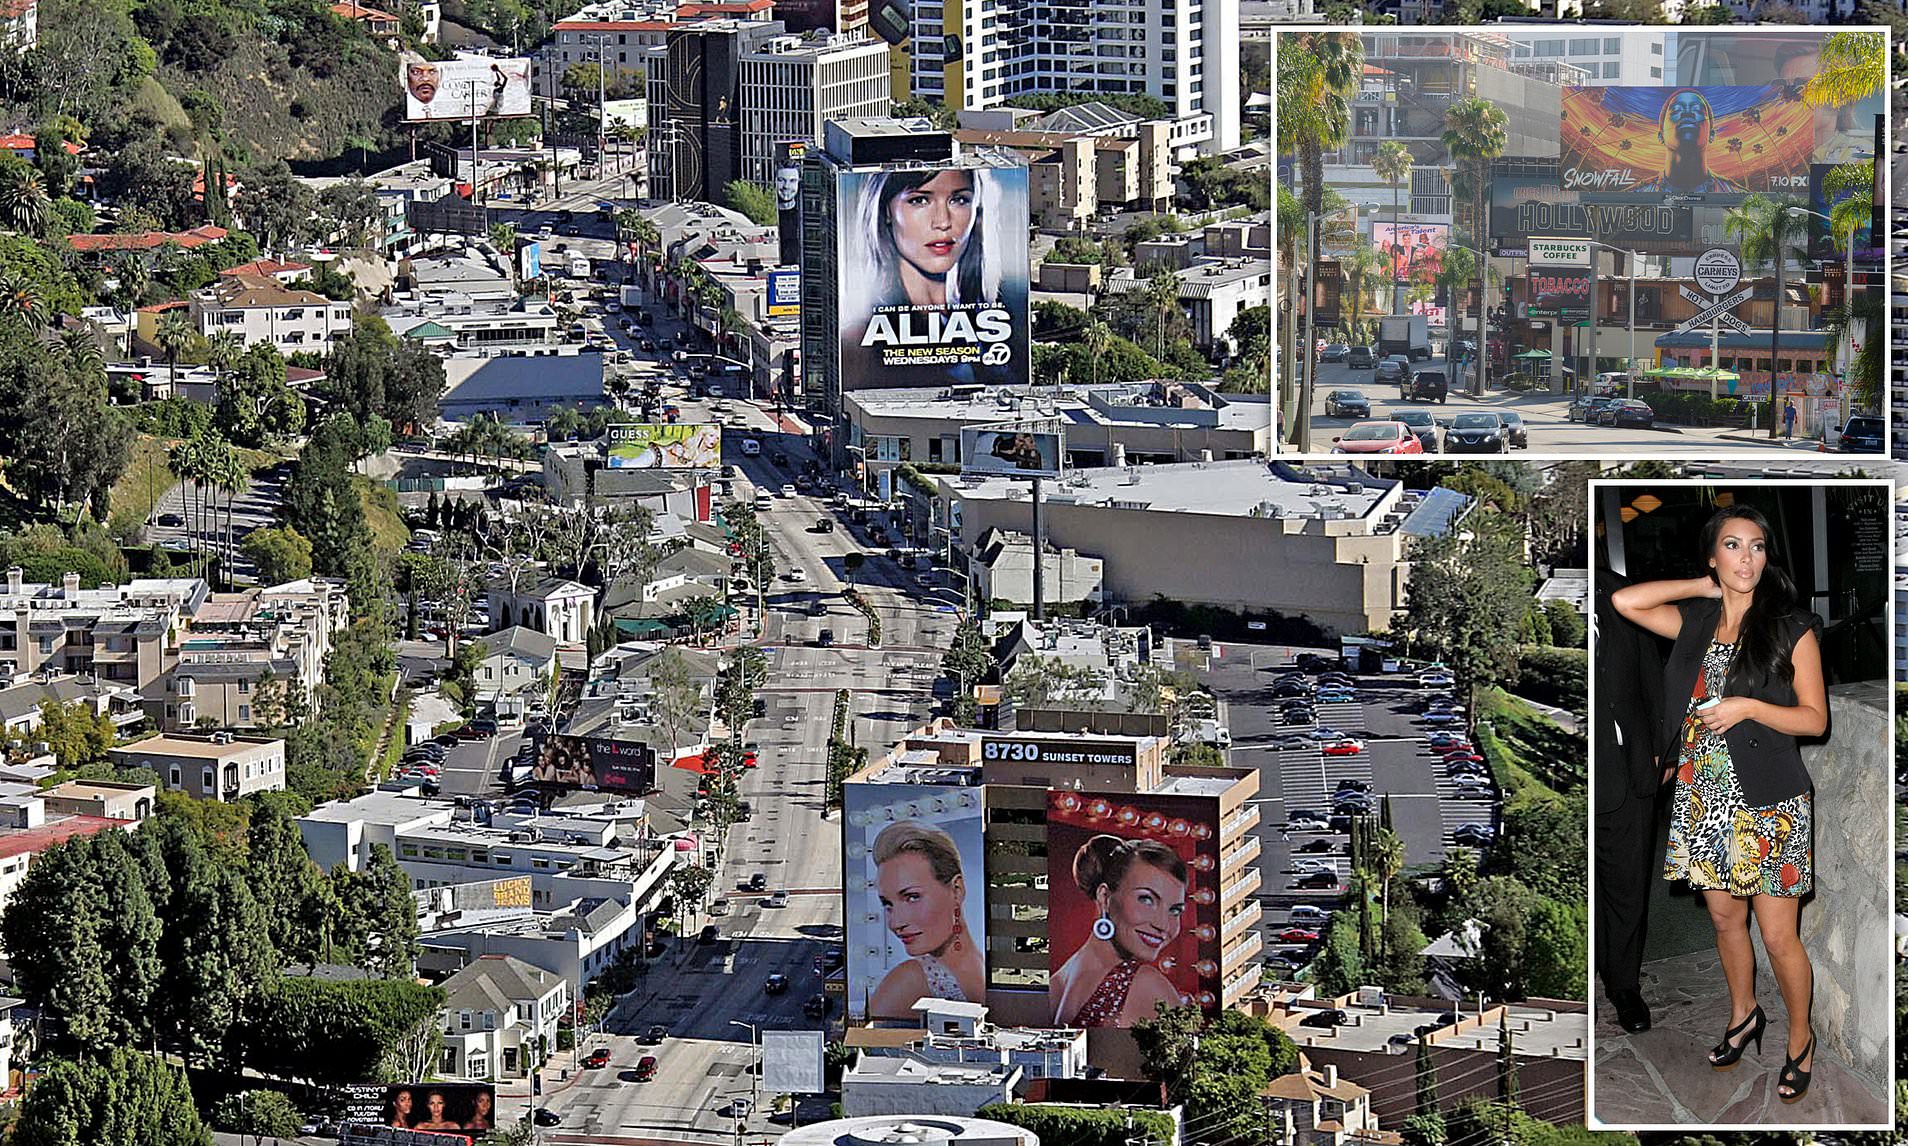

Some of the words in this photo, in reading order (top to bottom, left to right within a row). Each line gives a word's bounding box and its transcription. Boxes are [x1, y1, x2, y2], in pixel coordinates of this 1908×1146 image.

[1564, 168, 1637, 188] SNOWFALL
[1770, 176, 1789, 187] 7.10
[1518, 202, 1674, 234] HOLLYWOOD
[1533, 244, 1587, 252] STARBUCKS
[1698, 267, 1738, 276] CARNEYS
[1531, 277, 1590, 295] TOBACCO
[1705, 281, 1730, 291] LIMITED
[1686, 291, 1704, 305] HOT
[911, 303, 945, 312] ANYONE
[952, 303, 976, 311] WANT
[1688, 293, 1745, 328] HAMBURGERS
[861, 309, 1012, 346] ALIAS
[1723, 313, 1748, 332] DOGS
[883, 349, 905, 357] THE
[908, 348, 933, 356] NEW
[935, 346, 980, 355] SEASON
[883, 355, 958, 365] WEDNESDAYS
[961, 355, 980, 363] 9PM
[611, 429, 650, 439] GUESS
[596, 743, 611, 754] the
[612, 743, 619, 754] L
[620, 746, 641, 757] word
[984, 742, 1039, 761] 8730
[1042, 752, 1085, 763] SUNSET
[1087, 753, 1132, 764] TOWERS
[494, 886, 530, 899] BRAND
[496, 895, 530, 906] JEANS
